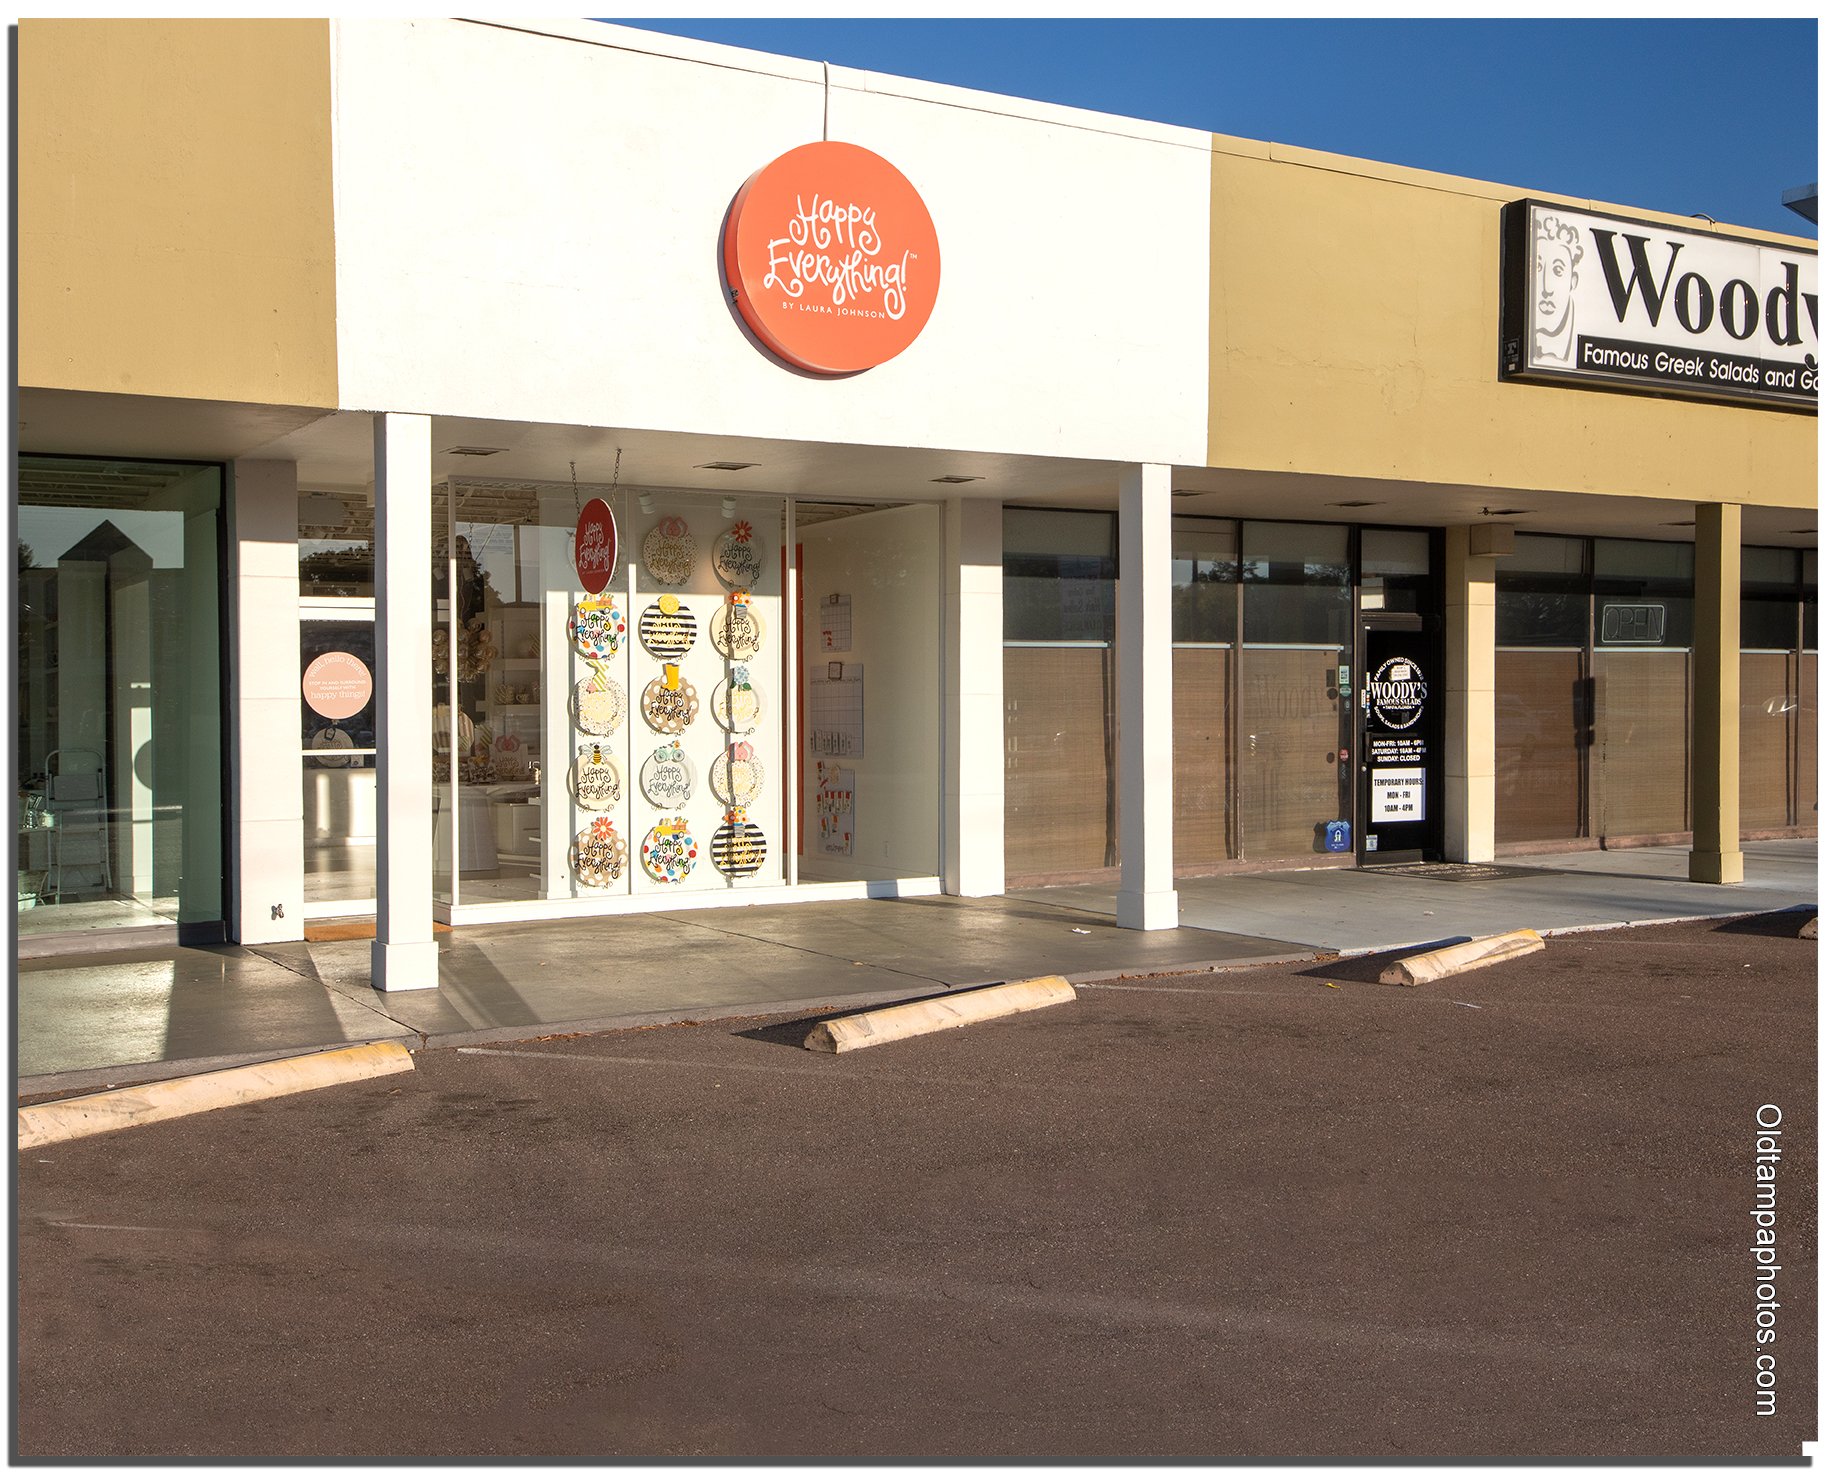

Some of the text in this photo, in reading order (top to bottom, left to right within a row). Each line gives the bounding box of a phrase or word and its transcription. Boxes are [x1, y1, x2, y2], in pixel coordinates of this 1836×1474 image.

[788, 193, 882, 256] Happy
[782, 301, 885, 319] BY LAURA JOHNSON
[1584, 343, 1648, 371] Famous
[1655, 351, 1704, 377] Greek
[1709, 357, 1759, 383] Salads
[1765, 370, 1795, 388] and
[1606, 608, 1662, 639] OPEN
[324, 655, 345, 664] hello
[311, 691, 337, 700] happy
[1370, 681, 1427, 699] WOODY'S
[1376, 698, 1422, 706] FAMOUS SALADS
[1387, 791, 1399, 799] MON
